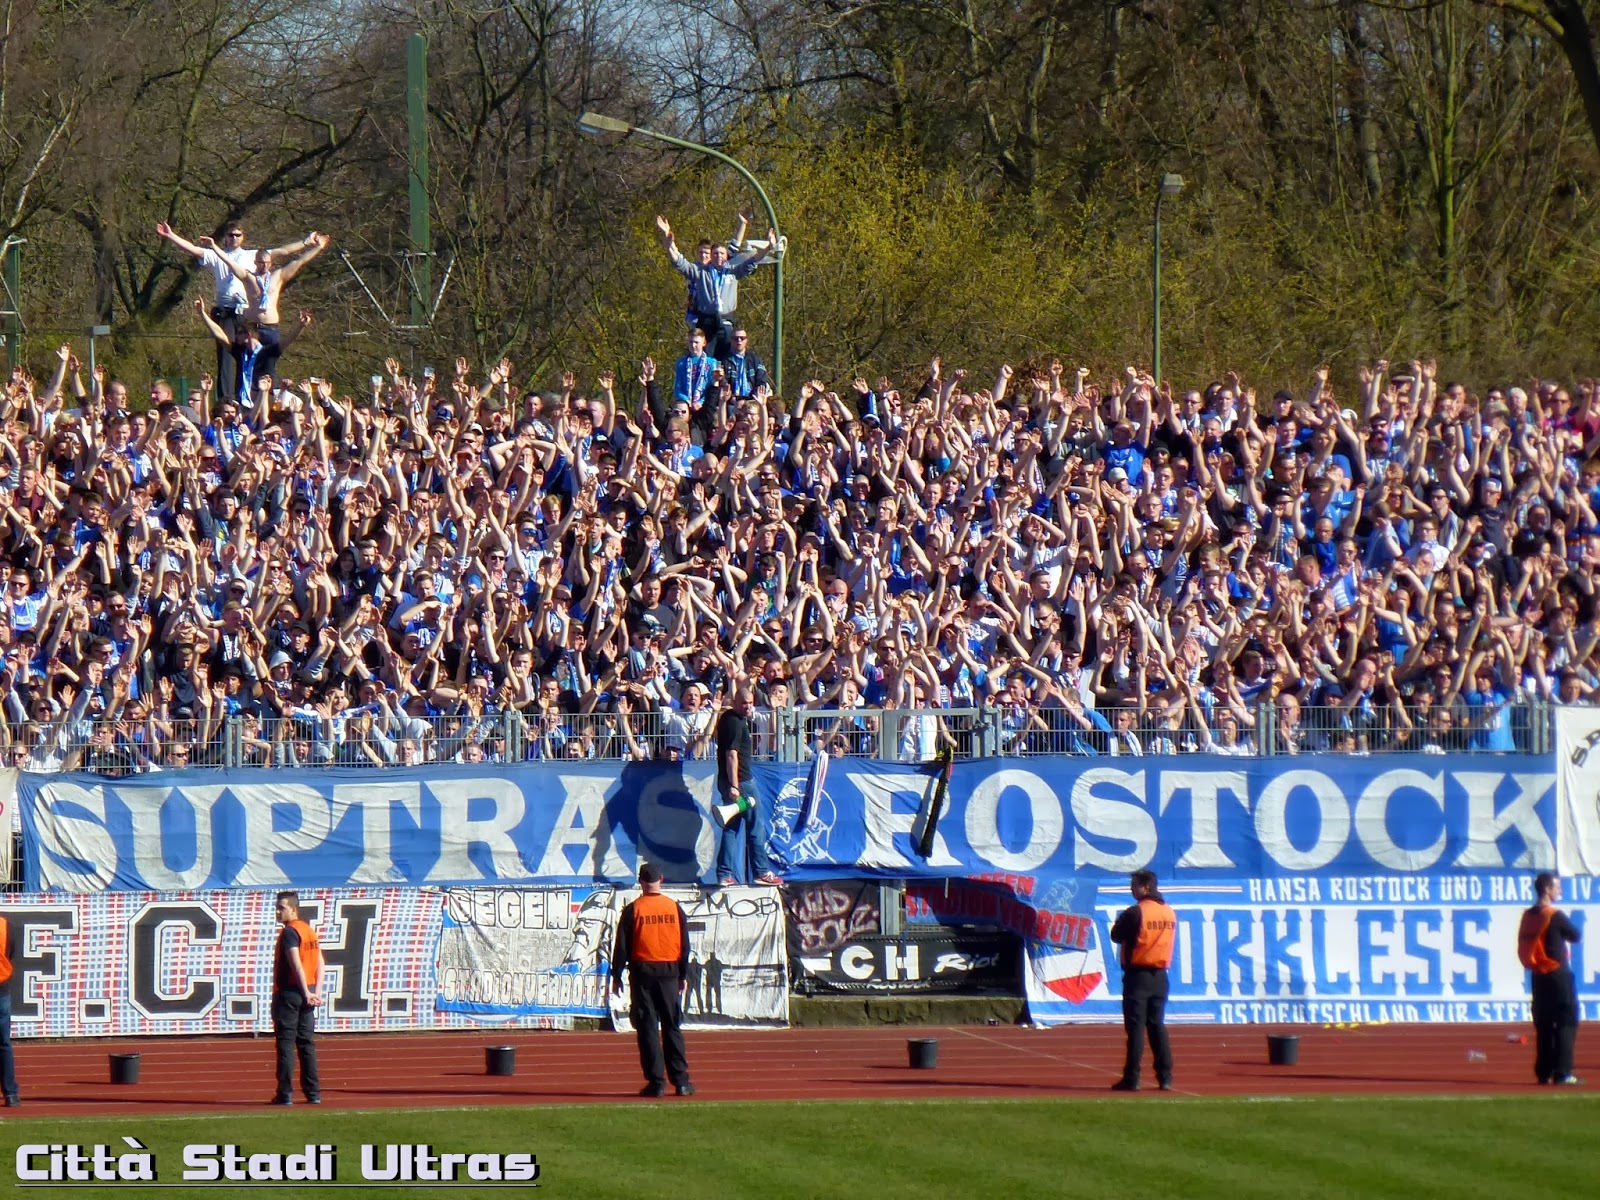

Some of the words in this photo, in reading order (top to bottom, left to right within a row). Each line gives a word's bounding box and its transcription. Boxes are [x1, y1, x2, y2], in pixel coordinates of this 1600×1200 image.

[33, 774, 717, 892] SUPTRAS
[846, 767, 1556, 873] ROSTOCK
[1250, 877, 1321, 902] HANSA
[1330, 876, 1430, 902] ROSTOCK
[1440, 876, 1483, 902] UND
[1571, 877, 1592, 901] IV
[640, 914, 676, 926] ORDNER
[1220, 1002, 1419, 1023] OSTDEUTSCHLAND
[1427, 1002, 1469, 1023] WIR
